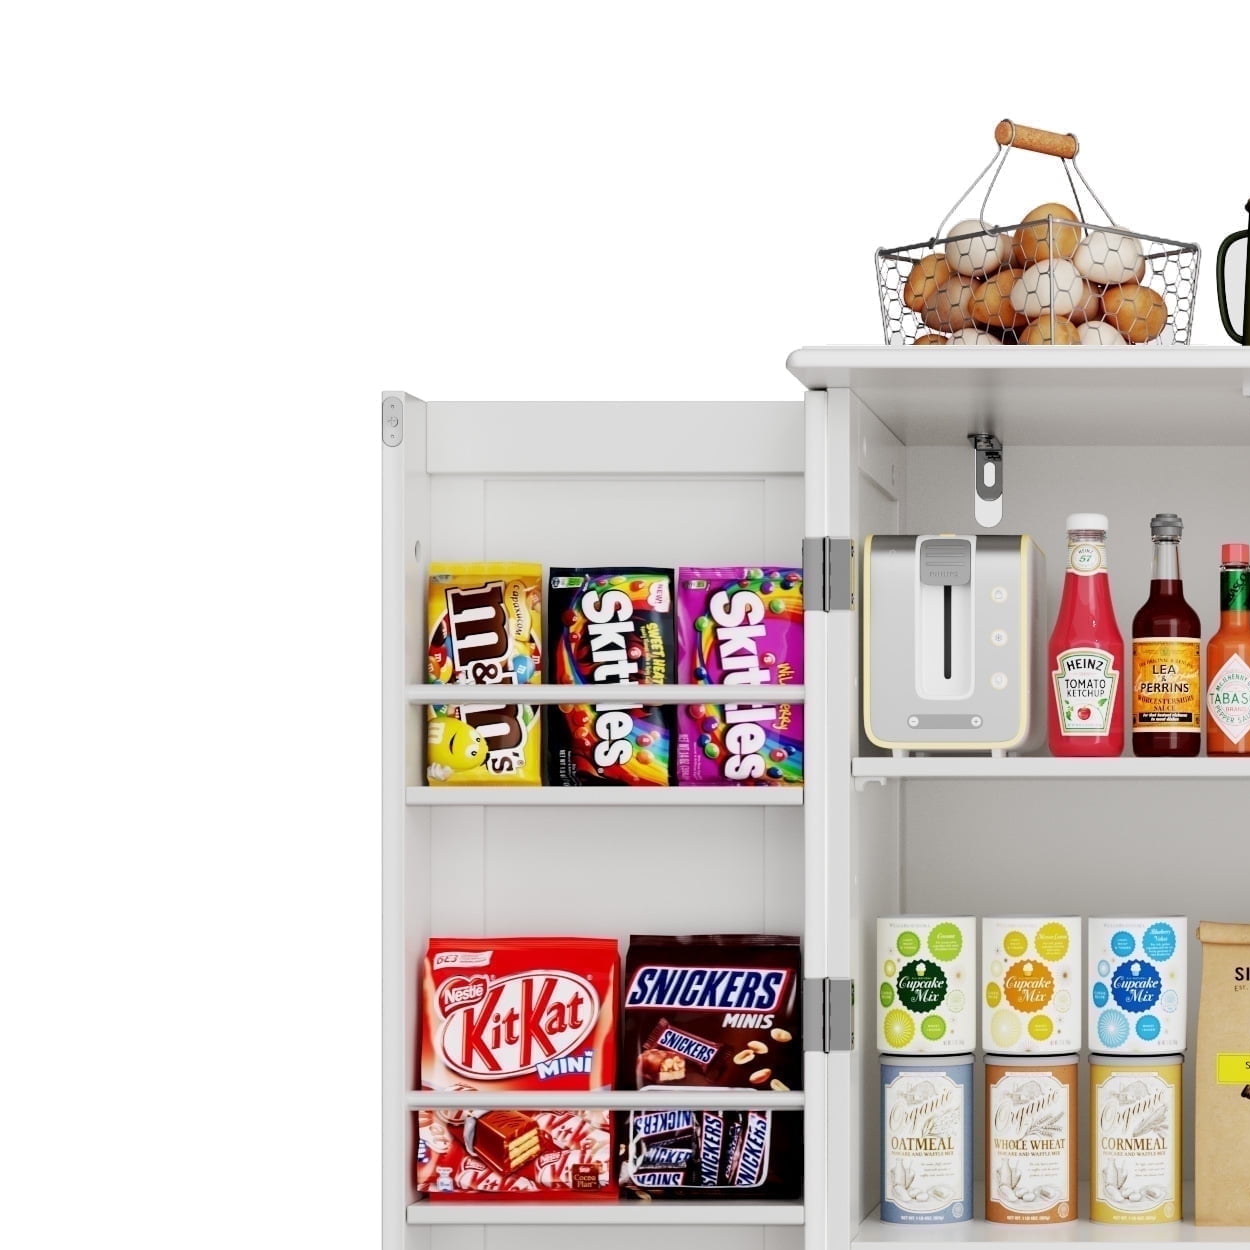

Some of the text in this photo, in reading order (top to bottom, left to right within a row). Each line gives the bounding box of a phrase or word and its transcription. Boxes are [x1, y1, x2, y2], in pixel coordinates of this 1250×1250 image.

[1079, 555, 1092, 563] 57
[646, 622, 664, 658] SWEET
[652, 659, 666, 685] HEAT
[1066, 658, 1104, 671] HEINZ
[1152, 664, 1176, 675] LEA
[581, 590, 644, 767] Skitles
[709, 590, 777, 780] Skitles
[1065, 679, 1106, 689] TOMATO
[1066, 689, 1105, 698] KETCHUP
[1141, 683, 1189, 693] PERRINS
[1215, 705, 1234, 723] PEPPER
[628, 968, 784, 1010] SNICKERS
[898, 977, 944, 992] Cupcake
[1005, 977, 1051, 992] Cupcake
[1113, 976, 1159, 992] Cupcake
[911, 989, 940, 1002] Mix
[1017, 989, 1047, 1002] Mix
[1125, 989, 1155, 1003] Mix
[722, 1014, 775, 1029] MINIS
[660, 1029, 716, 1062] SNICKERS
[889, 1087, 952, 1131] Organic
[994, 1087, 1057, 1132] Organic
[1100, 1087, 1164, 1133] Organic
[891, 1136, 955, 1151] OATMEAL
[994, 1138, 1065, 1151] WHOLE WHEAT
[1101, 1136, 1168, 1151] CORNMEAL
[574, 1174, 596, 1182] Cocoa
